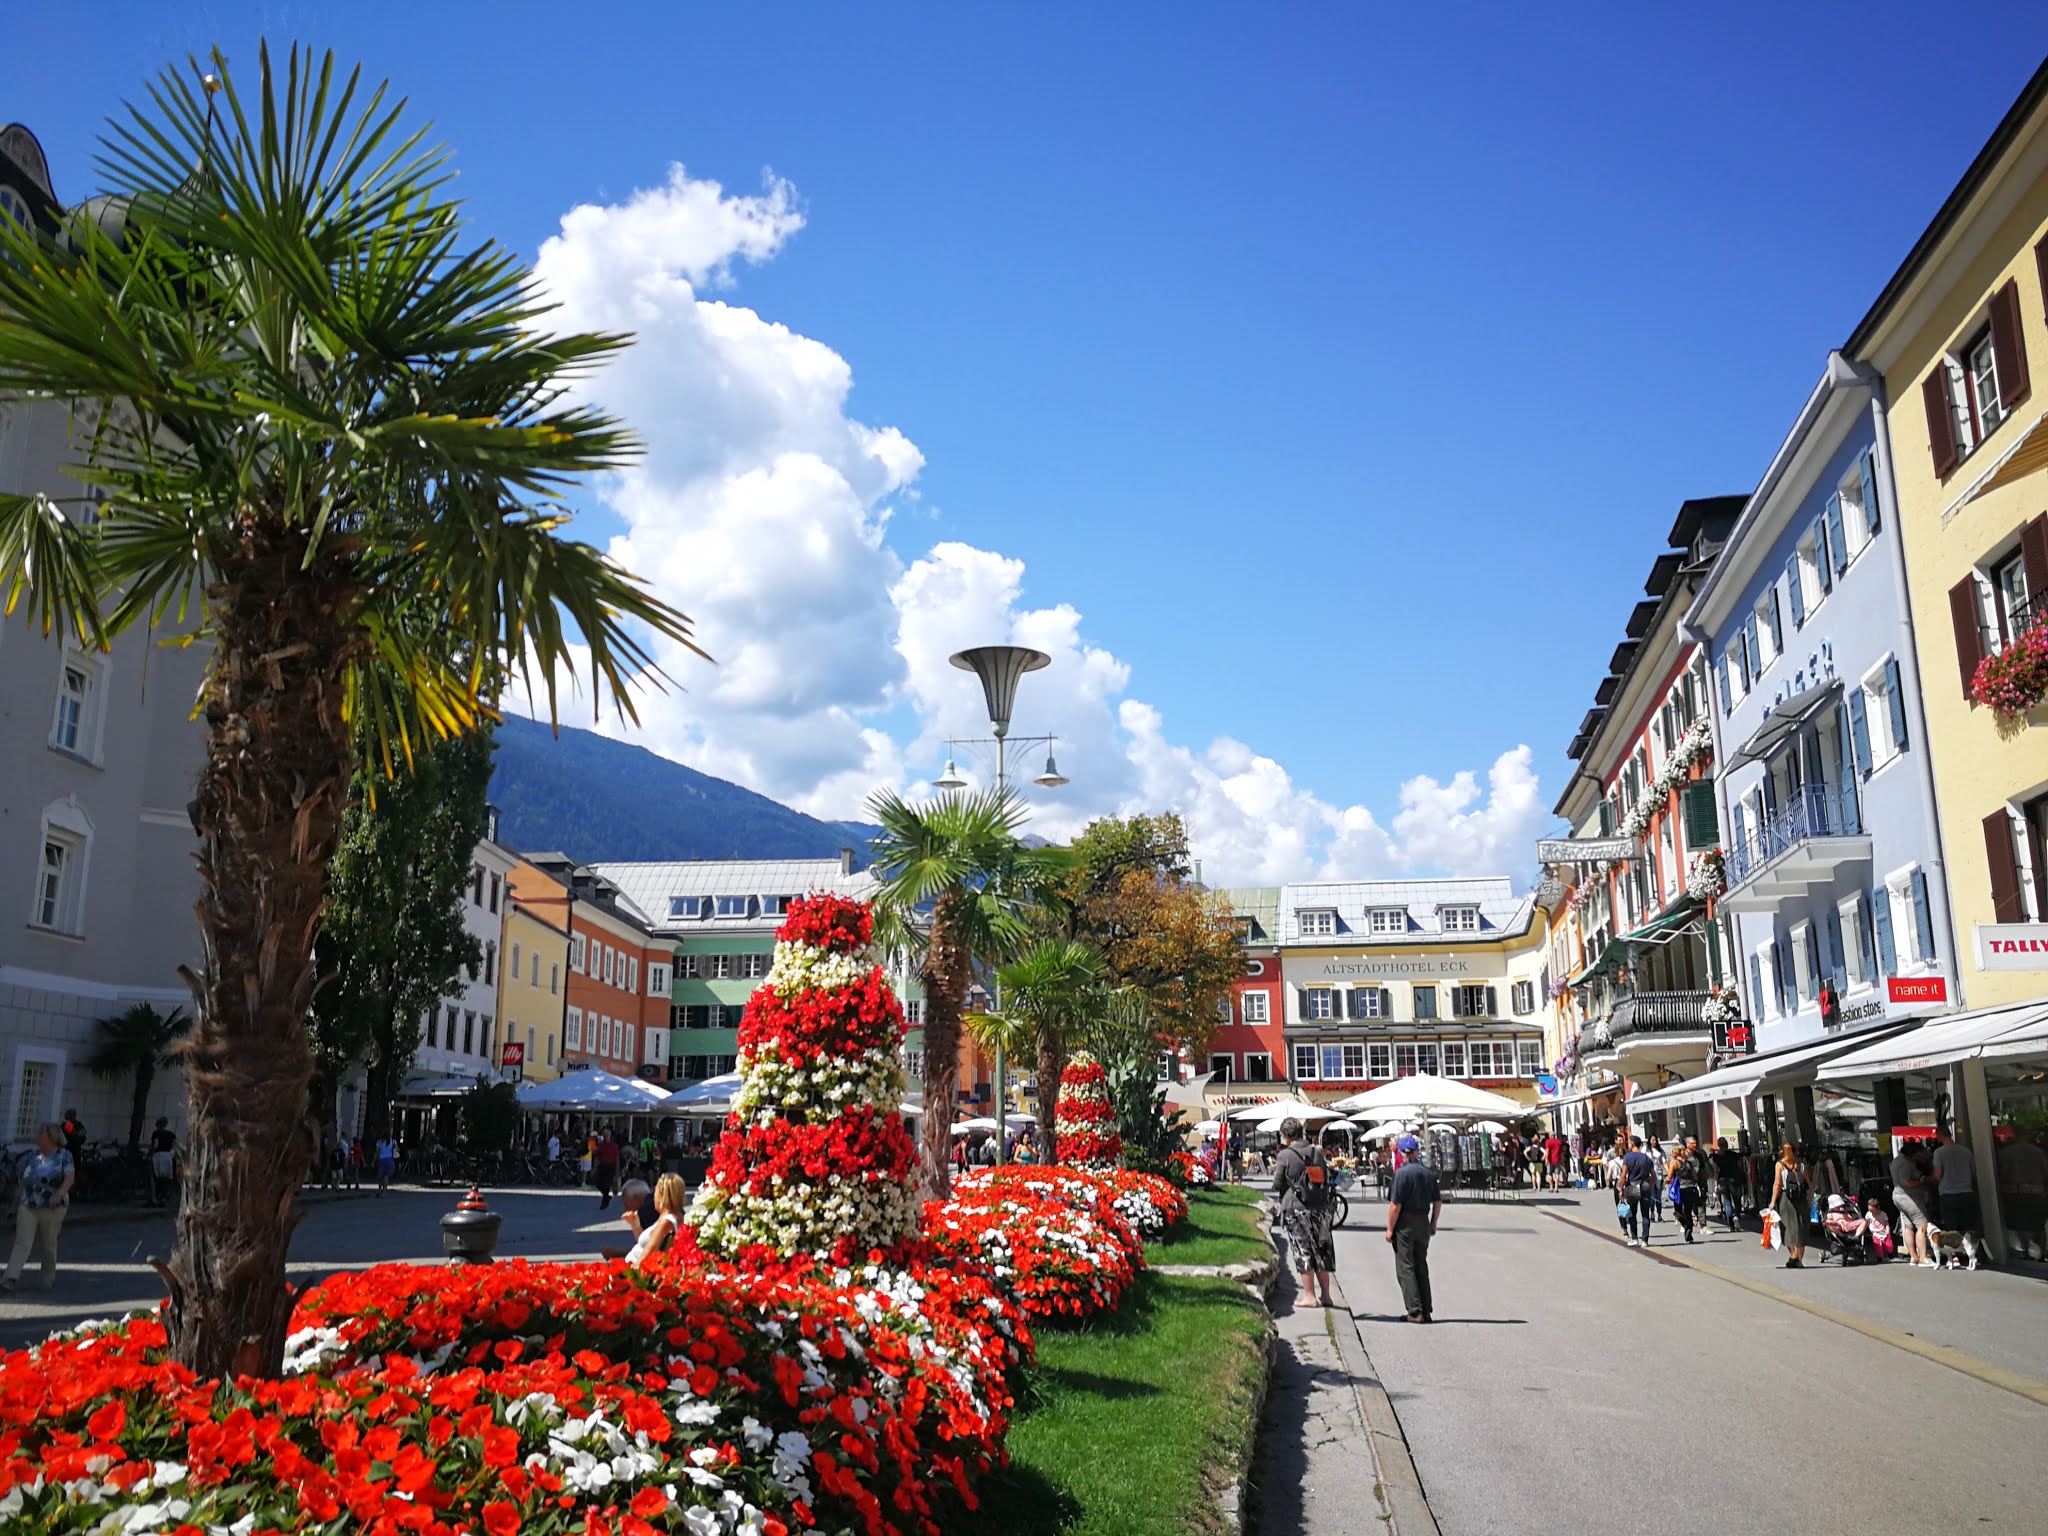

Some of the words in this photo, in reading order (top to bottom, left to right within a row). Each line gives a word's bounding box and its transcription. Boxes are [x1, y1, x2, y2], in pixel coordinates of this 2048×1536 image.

[1989, 939, 2048, 953] TALLY
[1323, 962, 1435, 974] ALTSTADTHOTEL
[1440, 961, 1468, 972] ECK
[1895, 985, 1928, 996] name
[1931, 983, 1938, 995] it
[504, 1046, 522, 1062] illy
